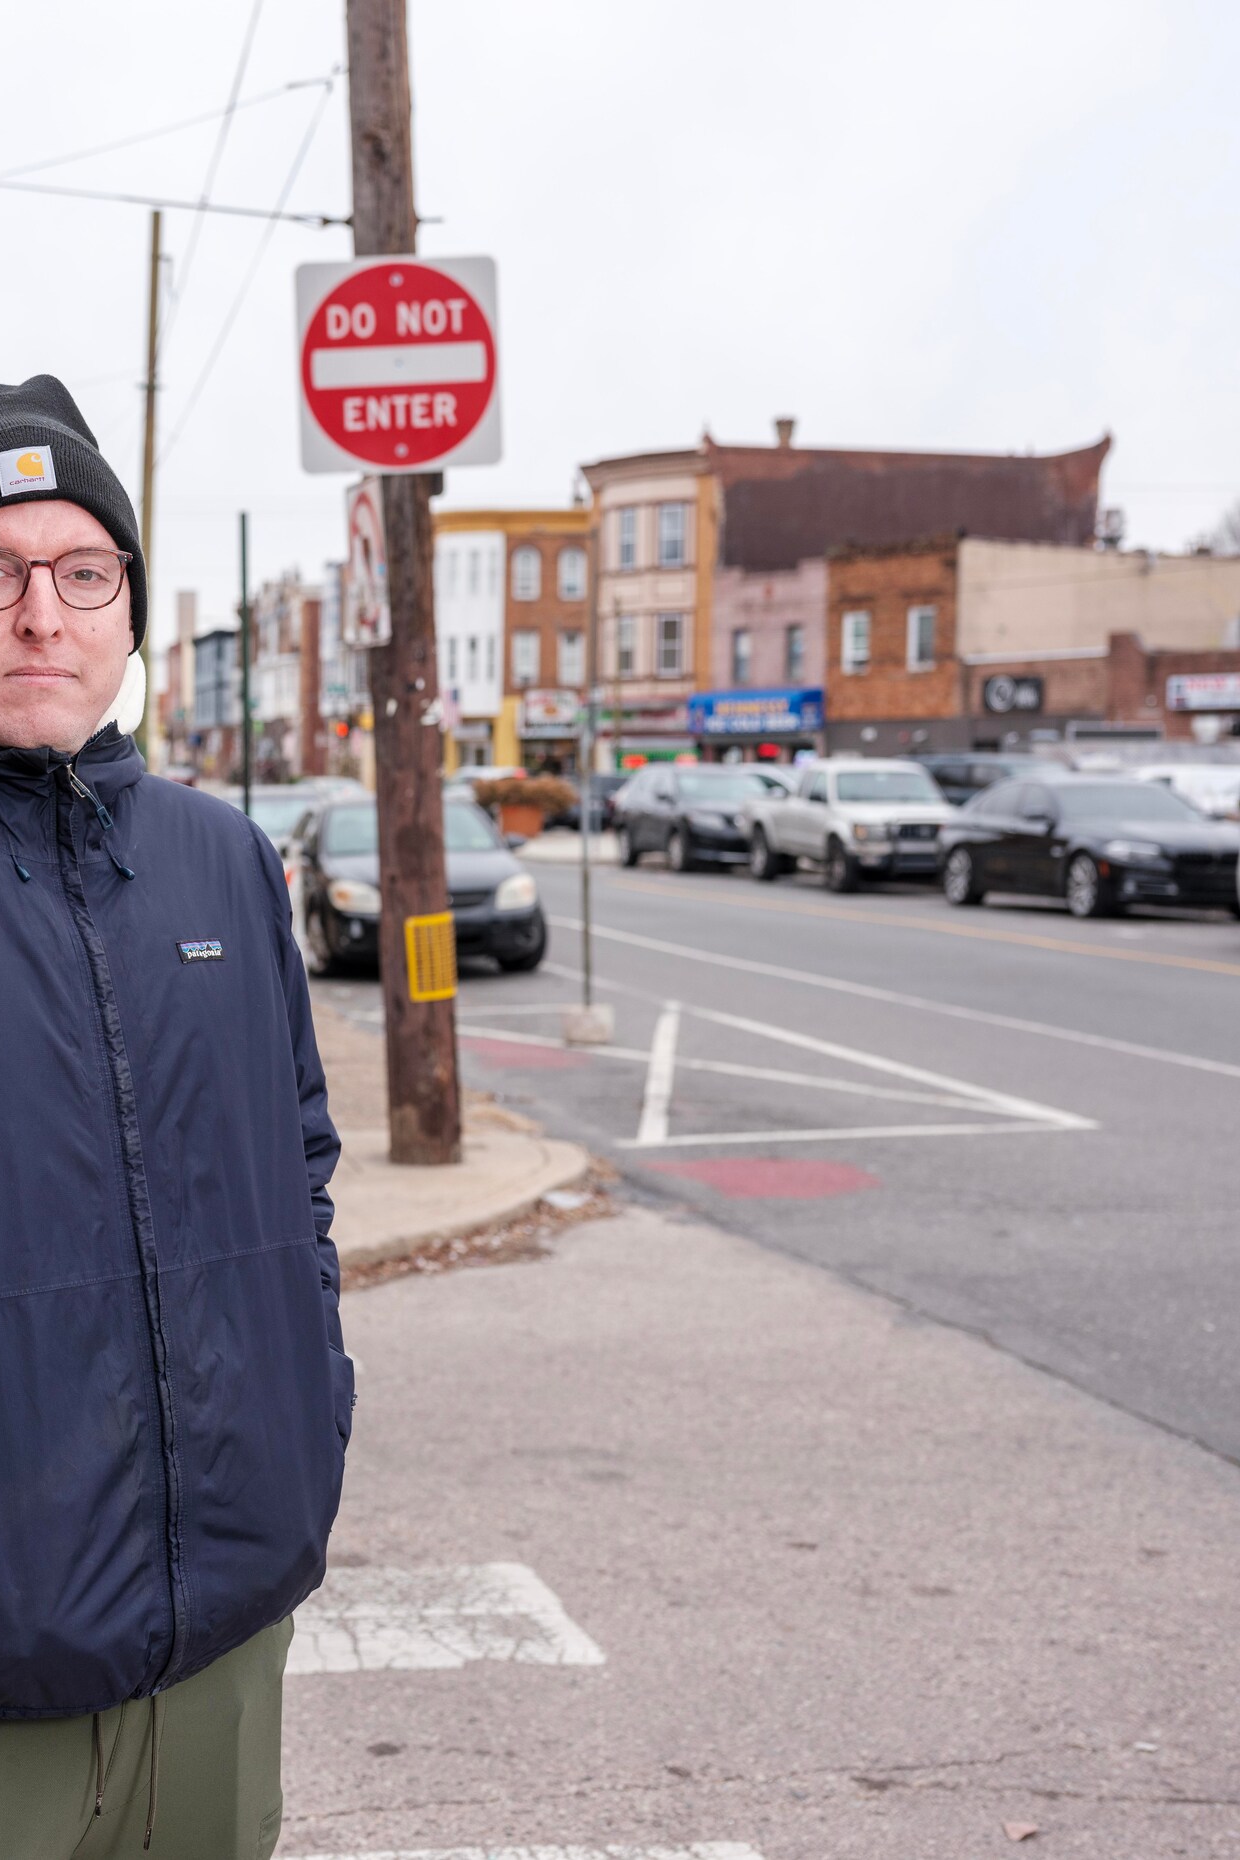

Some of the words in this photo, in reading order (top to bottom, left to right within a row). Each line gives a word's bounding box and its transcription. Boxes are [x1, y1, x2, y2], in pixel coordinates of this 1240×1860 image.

[325, 302, 377, 340] DO
[395, 298, 468, 337] NOT
[343, 392, 458, 432] ENTER
